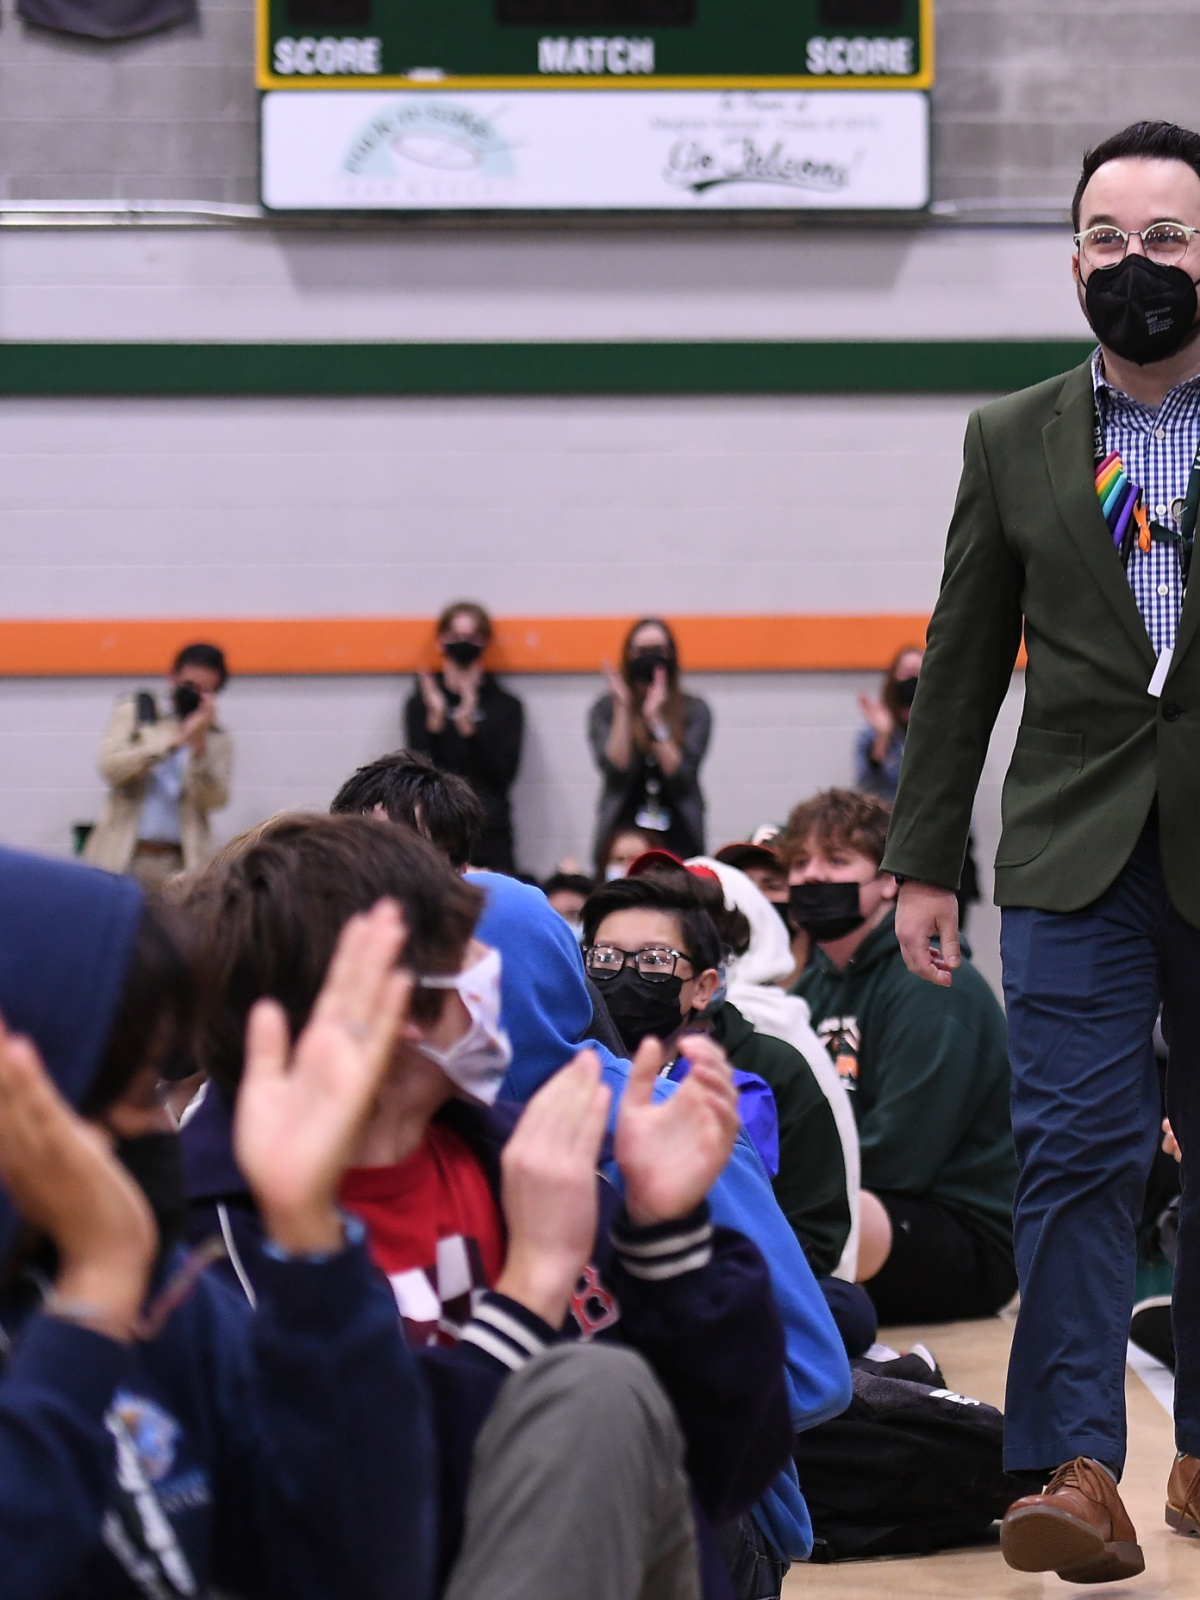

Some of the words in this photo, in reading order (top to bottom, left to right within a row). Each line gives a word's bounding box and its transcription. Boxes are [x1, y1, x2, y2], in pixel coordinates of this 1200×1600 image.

[274, 36, 381, 75] SCORE
[538, 36, 653, 75] MATCH
[806, 36, 912, 75] SCORE
